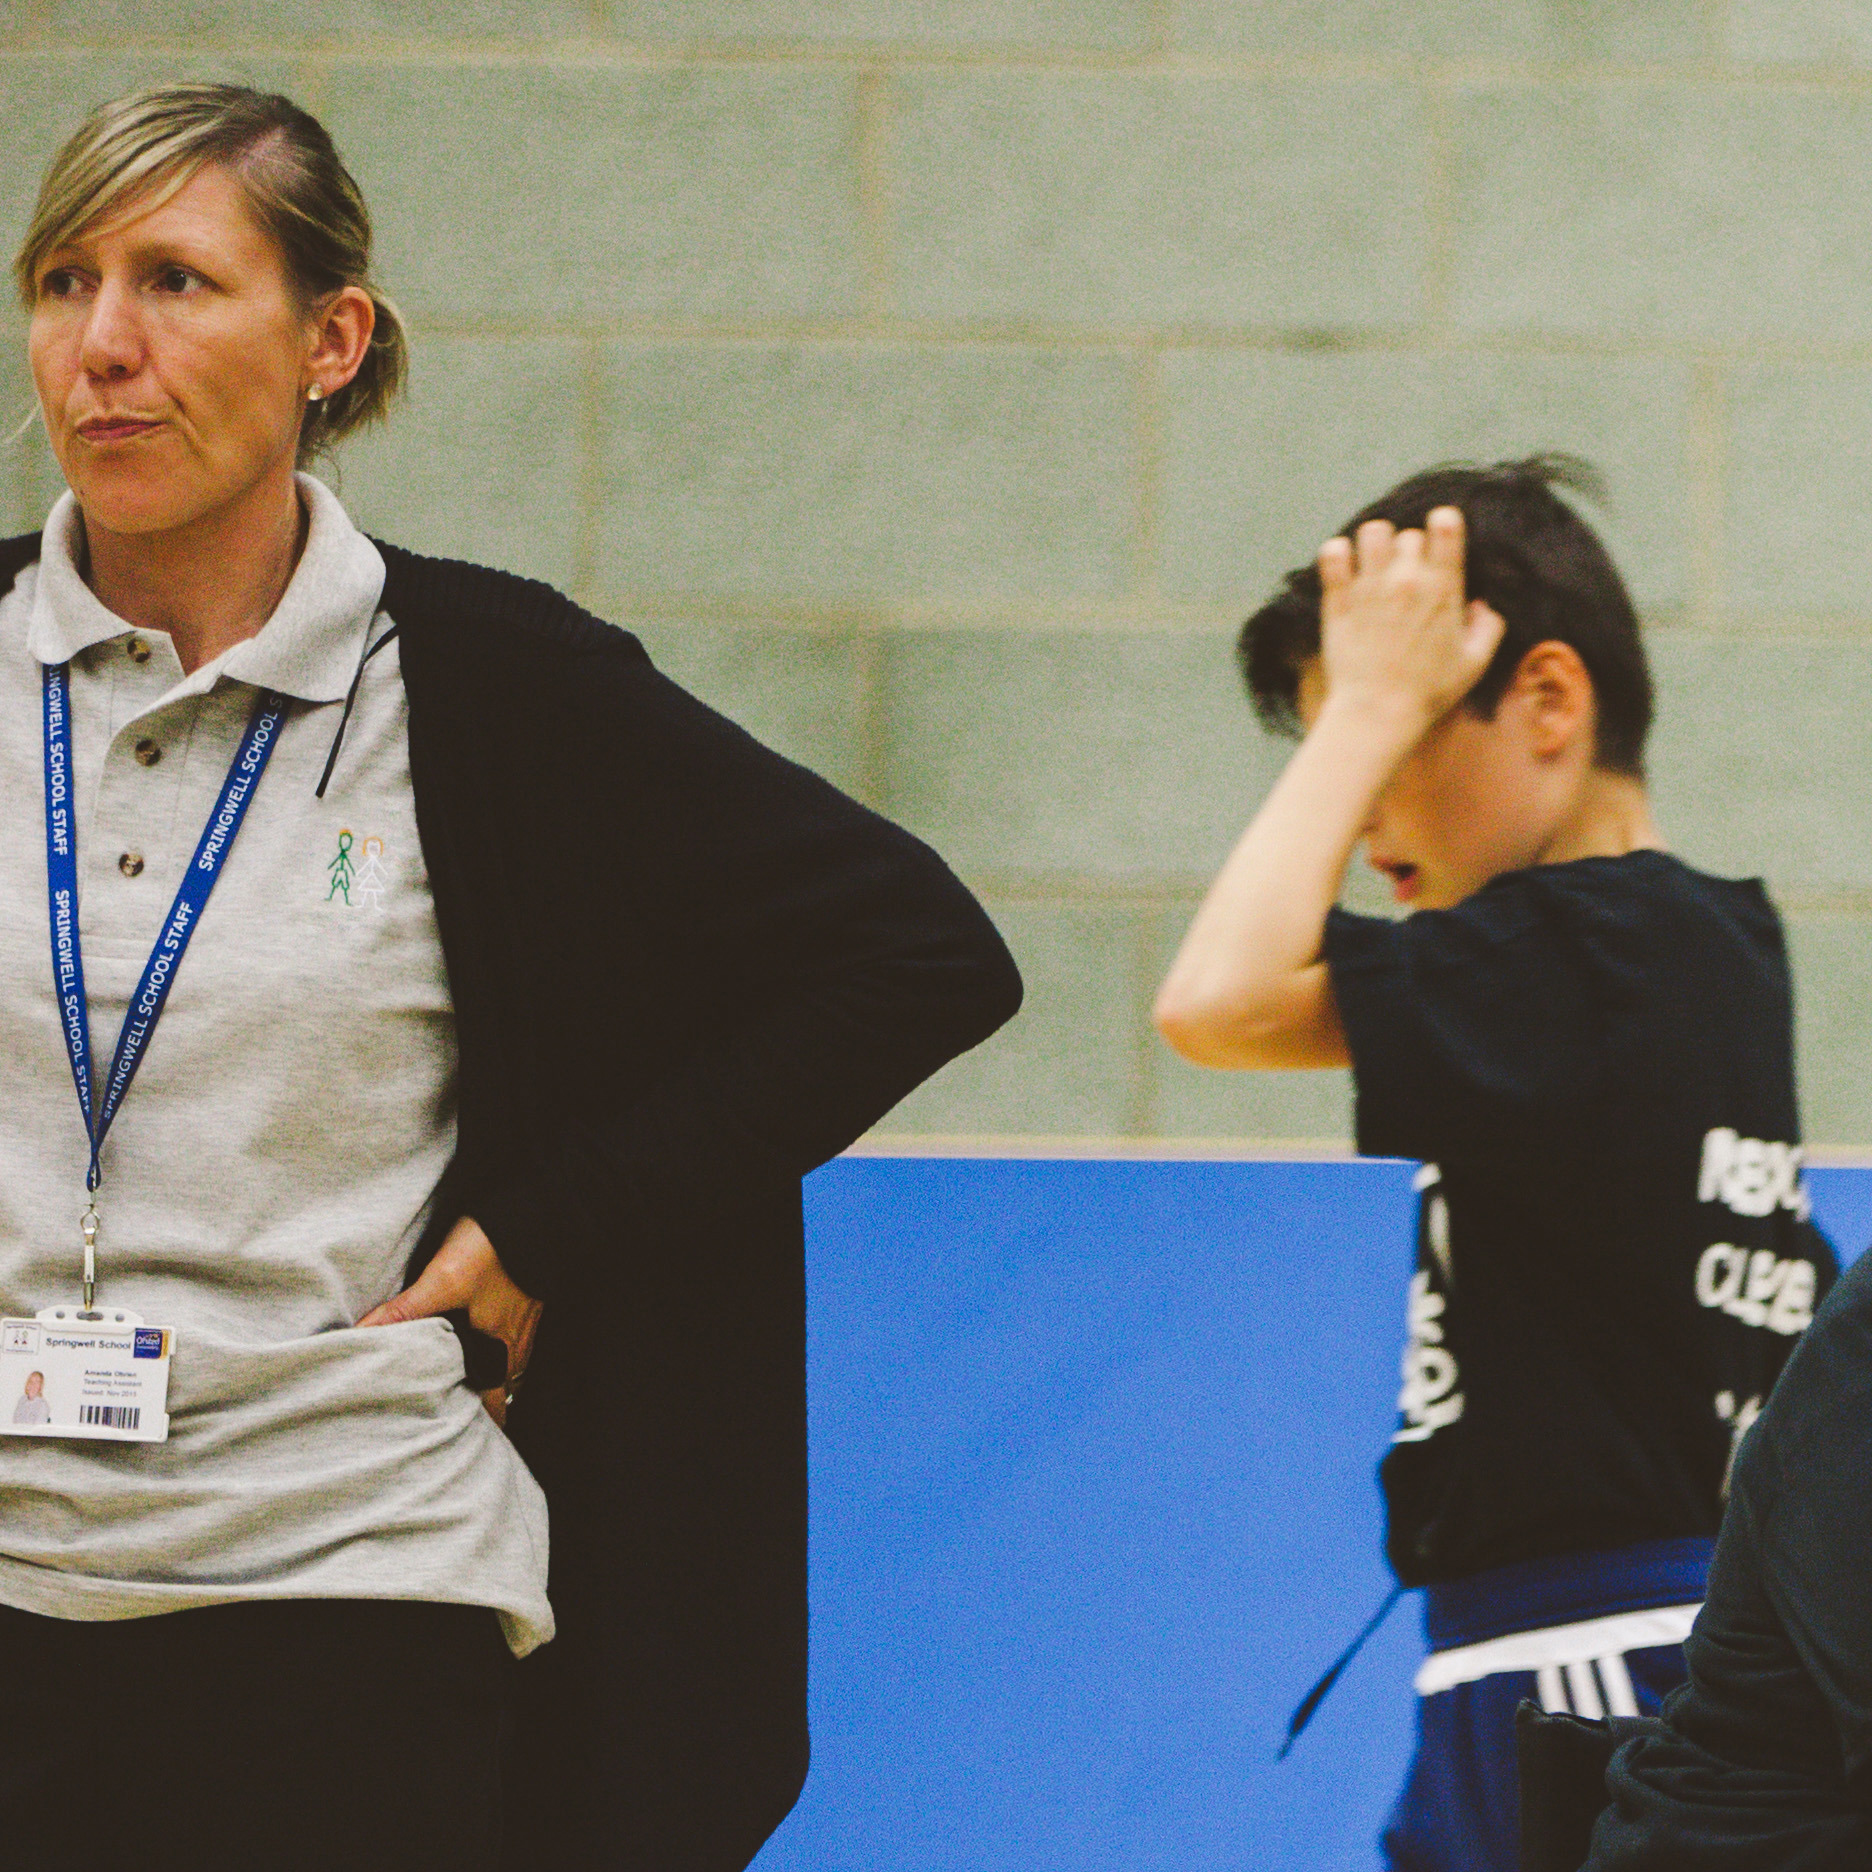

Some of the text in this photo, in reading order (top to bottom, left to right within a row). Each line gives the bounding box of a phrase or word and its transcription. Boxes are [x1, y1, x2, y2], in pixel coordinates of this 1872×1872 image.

[48, 668, 69, 856] INGWELL SCHOOL STAFF
[198, 711, 279, 872] SPRINGWELL SCHOOL
[55, 889, 91, 1114] SPRINGWELL SCHOOL STAFF
[104, 900, 195, 1120] SPRINGWELL SCHOOL STAFF
[46, 1337, 96, 1350] Springwell
[98, 1339, 132, 1350] School
